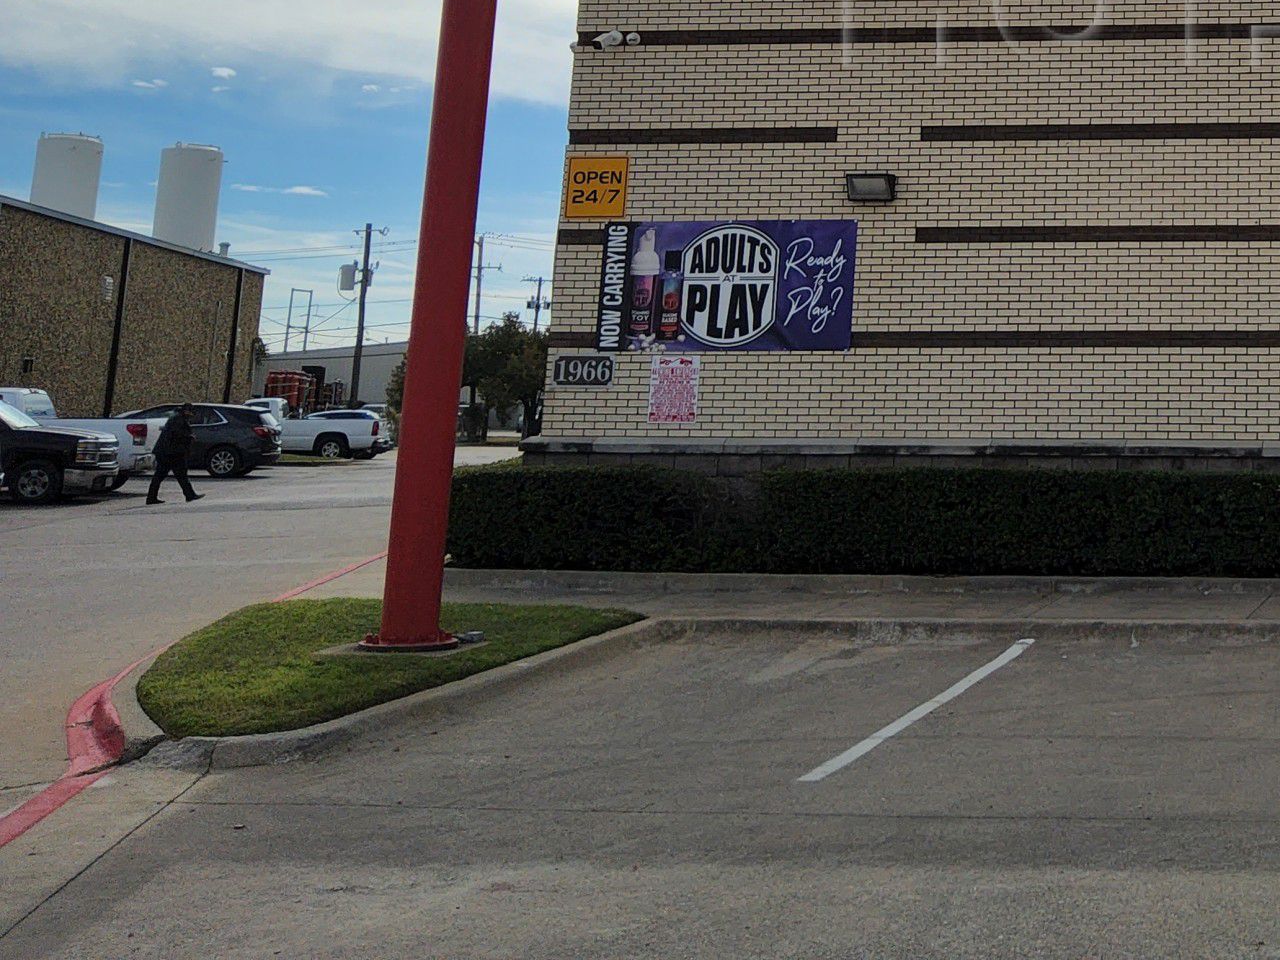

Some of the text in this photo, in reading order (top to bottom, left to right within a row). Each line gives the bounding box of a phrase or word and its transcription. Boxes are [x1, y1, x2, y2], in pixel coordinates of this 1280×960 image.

[573, 170, 623, 185] OPEN
[572, 188, 621, 204] 24/7
[690, 233, 772, 274] ADULTS
[783, 237, 848, 283] Ready
[599, 225, 629, 348] NOW CARRYING
[722, 274, 738, 283] AT
[813, 268, 827, 292] to
[686, 283, 770, 339] PLAY
[783, 286, 844, 334] Play?
[556, 359, 611, 382] 1966
